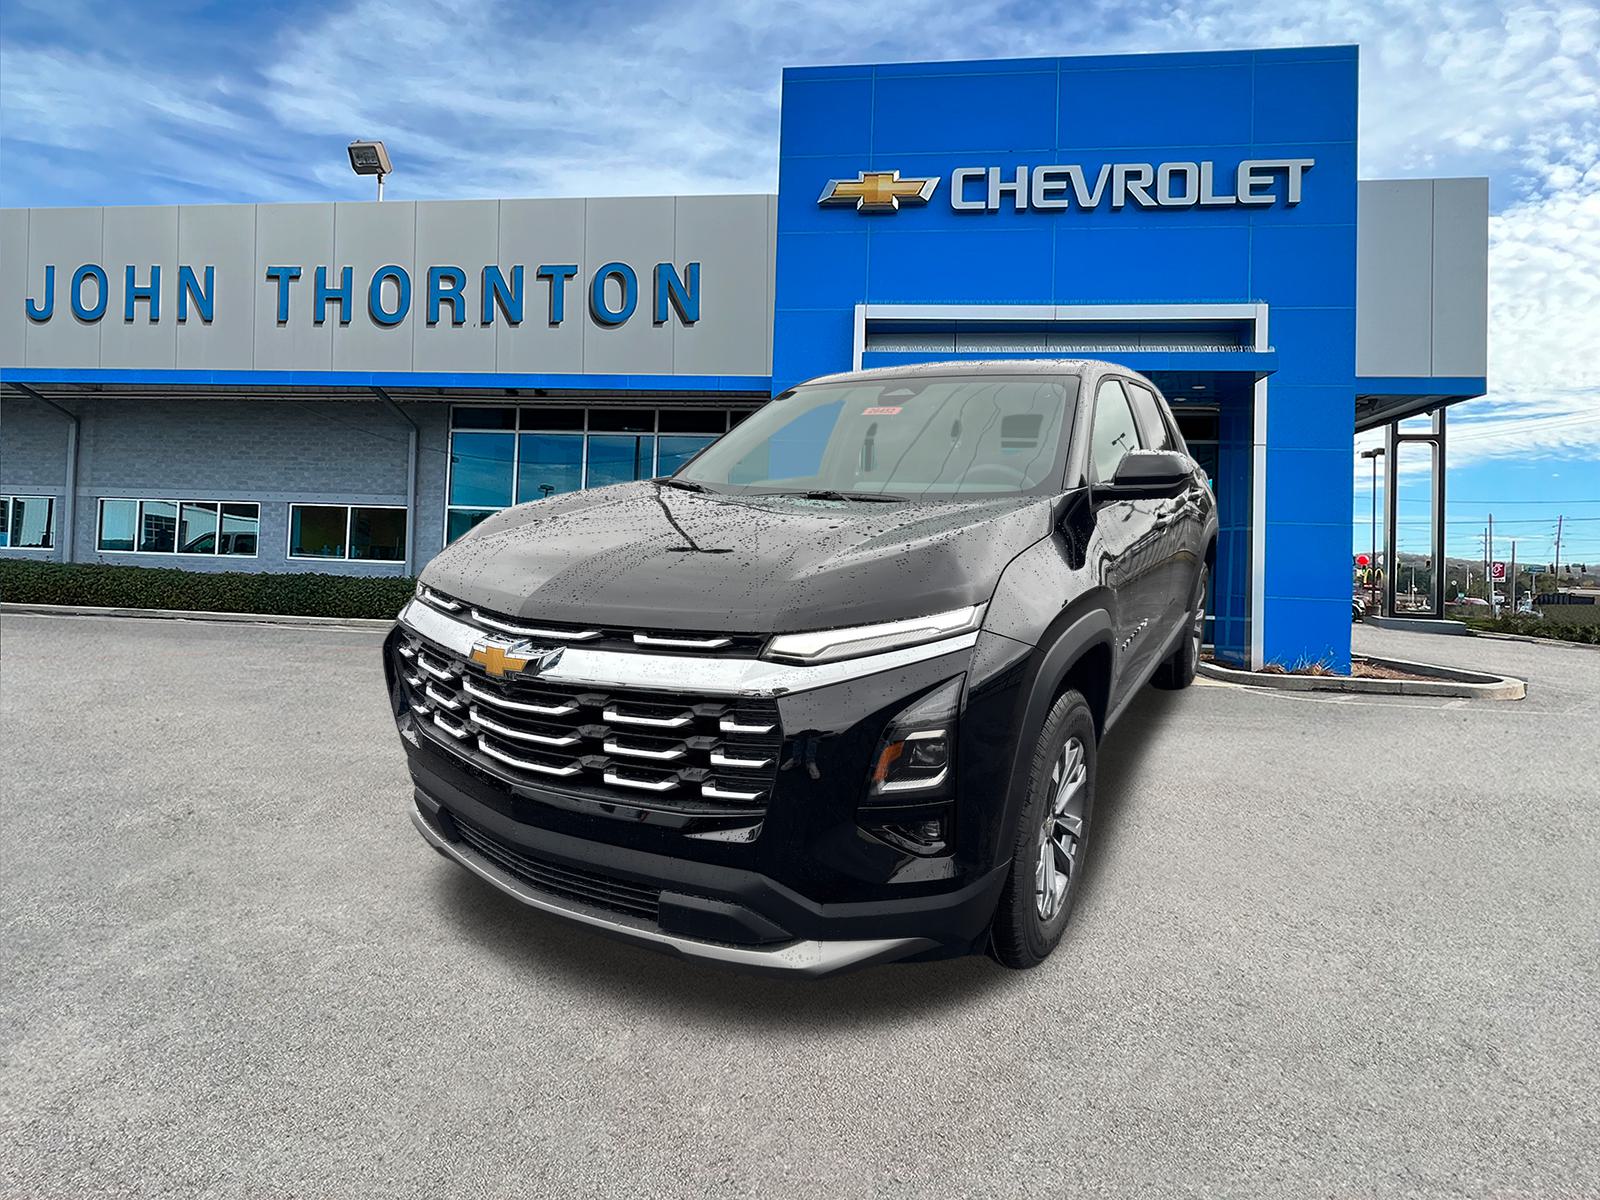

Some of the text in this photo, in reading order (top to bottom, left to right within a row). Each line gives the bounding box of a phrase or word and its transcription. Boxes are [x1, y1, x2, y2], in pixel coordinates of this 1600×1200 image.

[950, 158, 1315, 210] CHEVROLET
[26, 261, 702, 326] JOHN THORNTON
